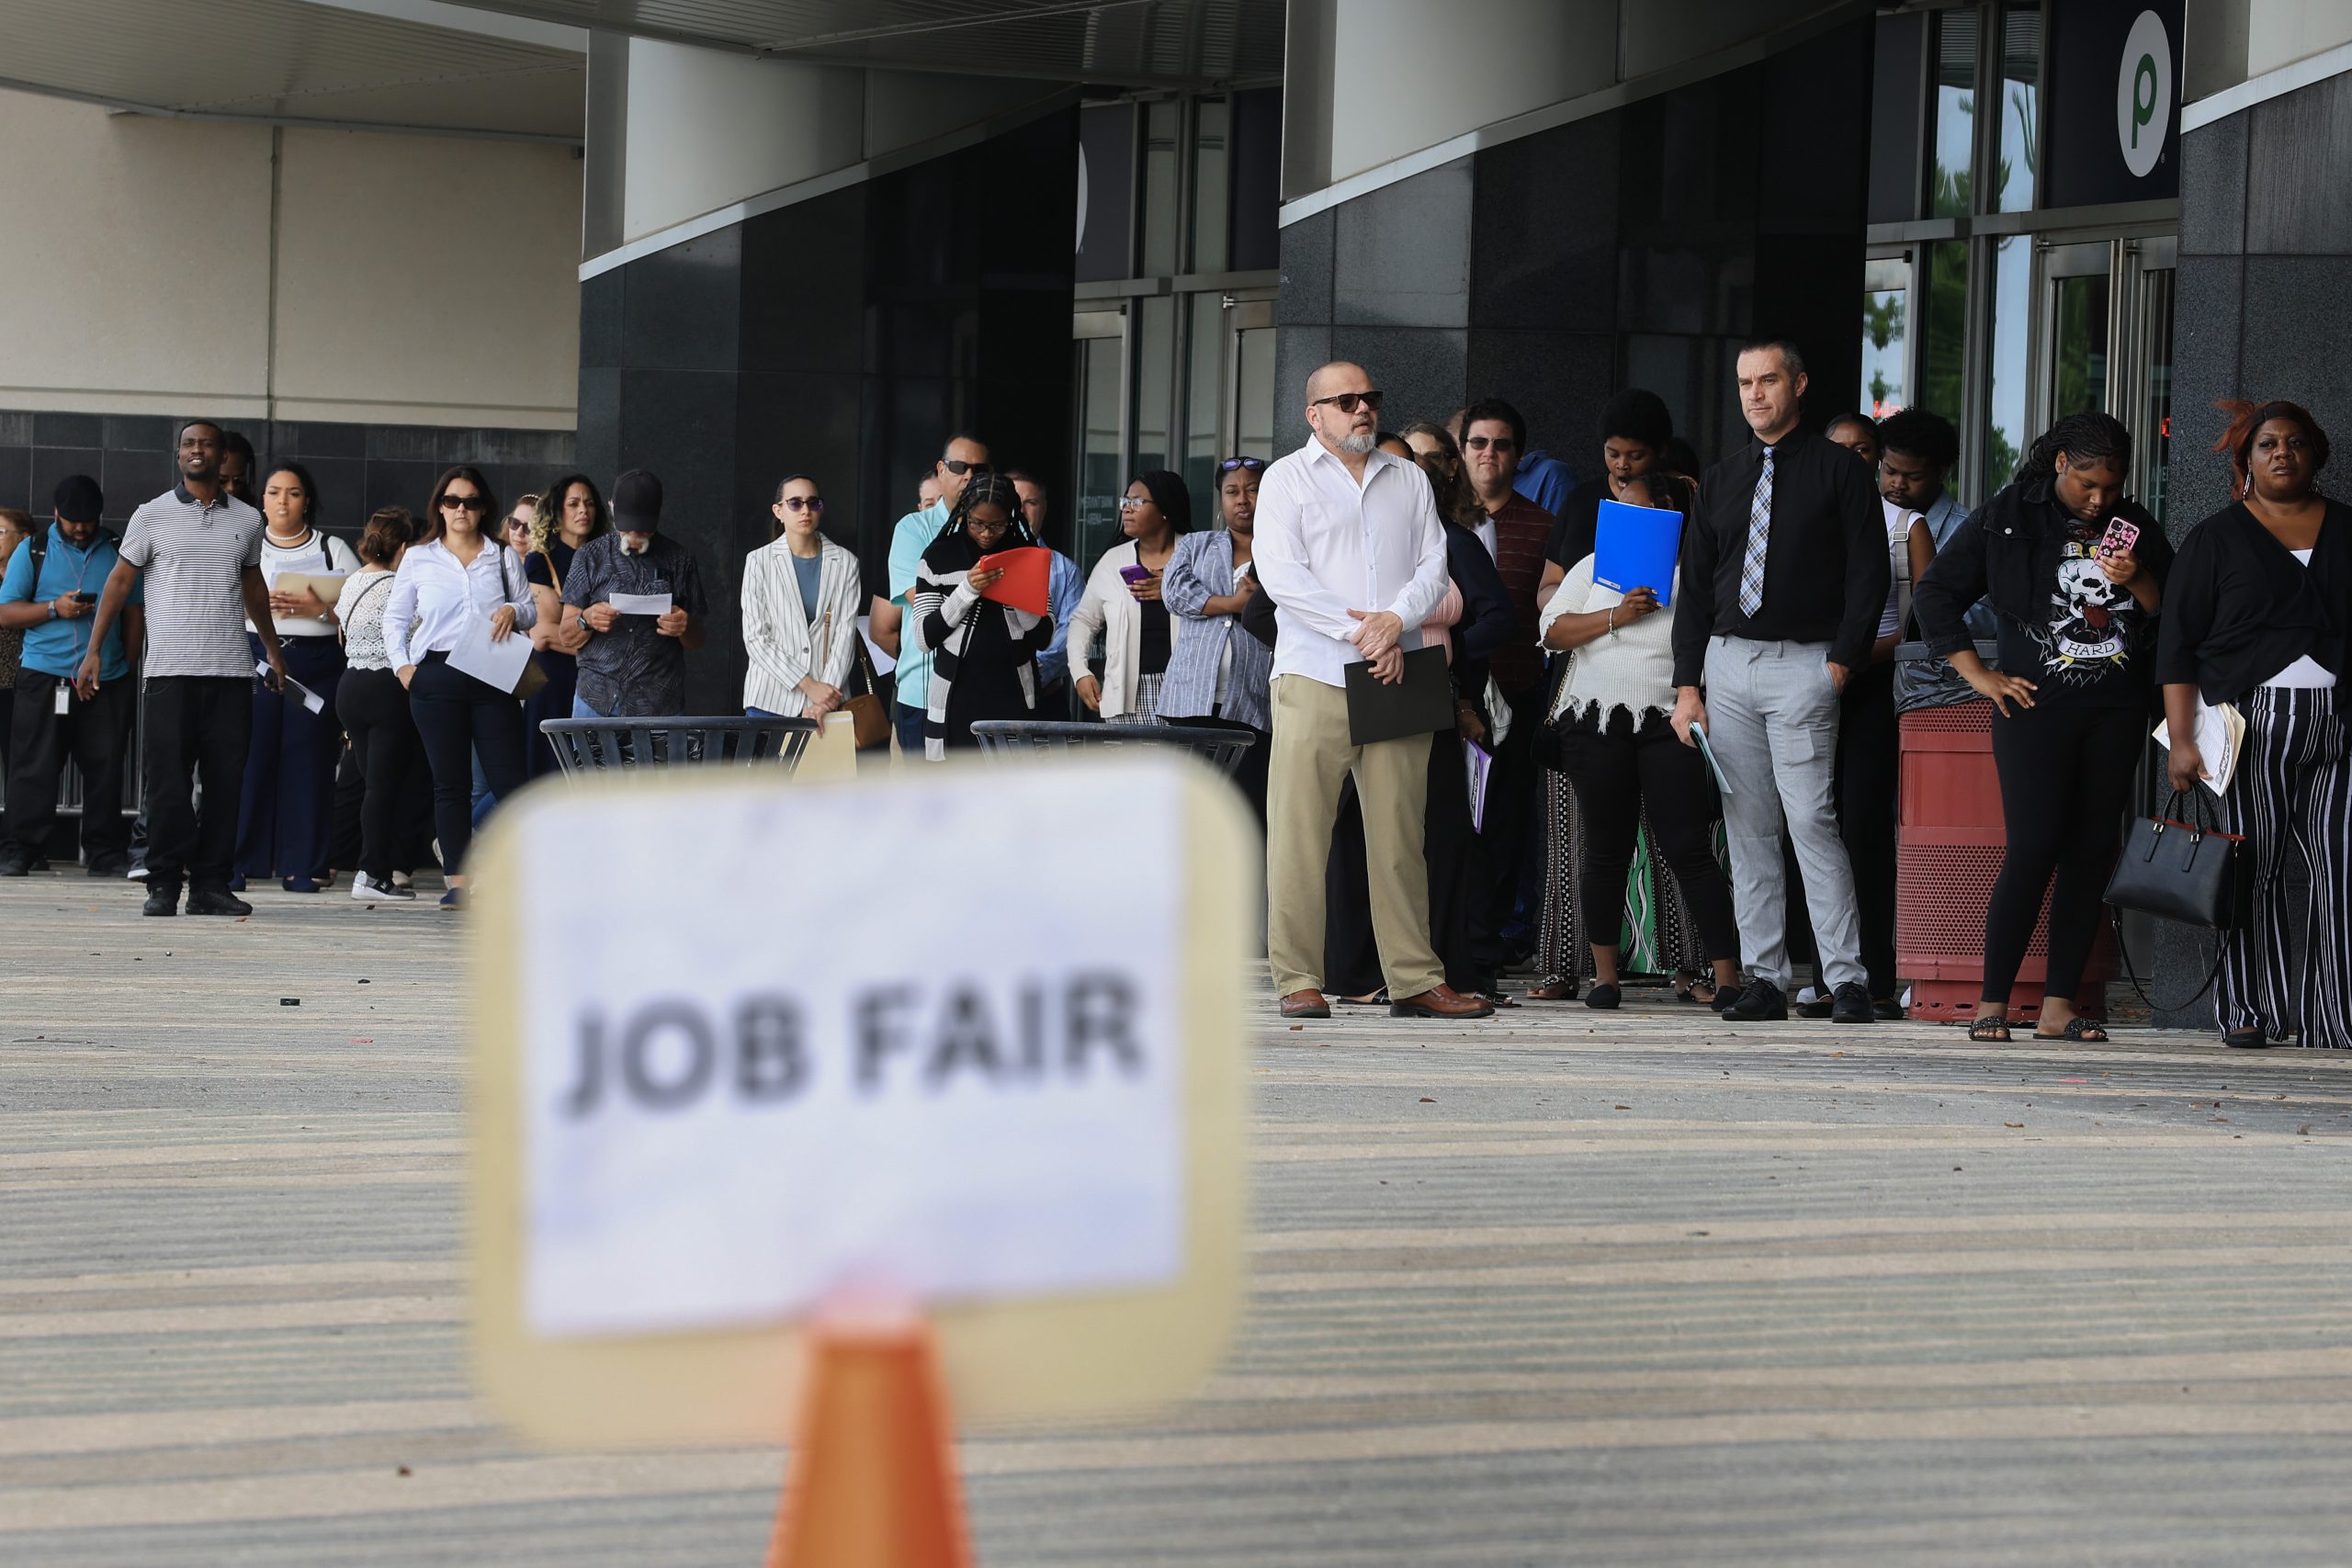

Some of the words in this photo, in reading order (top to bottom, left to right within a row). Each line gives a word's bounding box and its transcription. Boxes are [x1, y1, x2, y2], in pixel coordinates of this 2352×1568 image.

[2065, 642, 2115, 656] HARD
[559, 993, 813, 1122] JOB
[850, 968, 1147, 1095] FAIR
